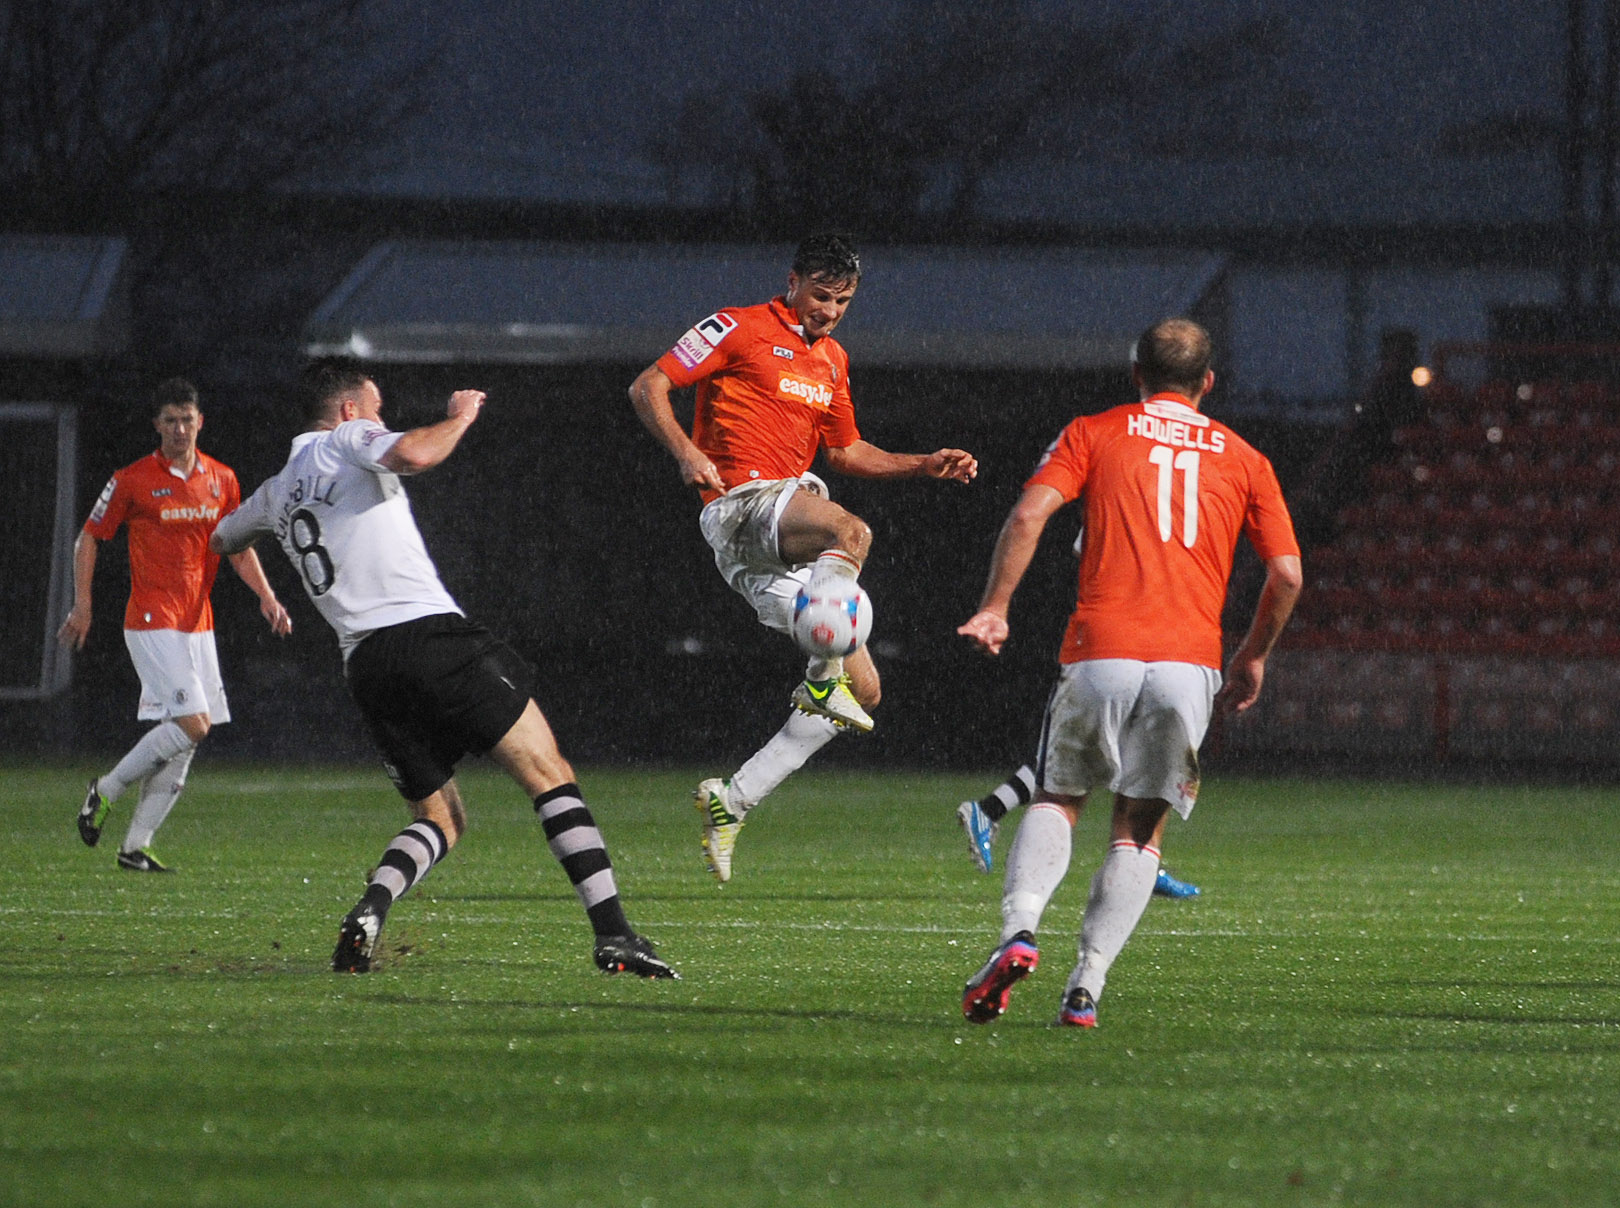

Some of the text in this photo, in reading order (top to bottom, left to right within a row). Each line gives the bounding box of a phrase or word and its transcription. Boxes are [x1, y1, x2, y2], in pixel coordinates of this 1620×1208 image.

[779, 378, 833, 407] easyJe
[1127, 413, 1226, 454] HOWELLS
[1148, 445, 1201, 549] 11
[289, 507, 336, 597] 8
